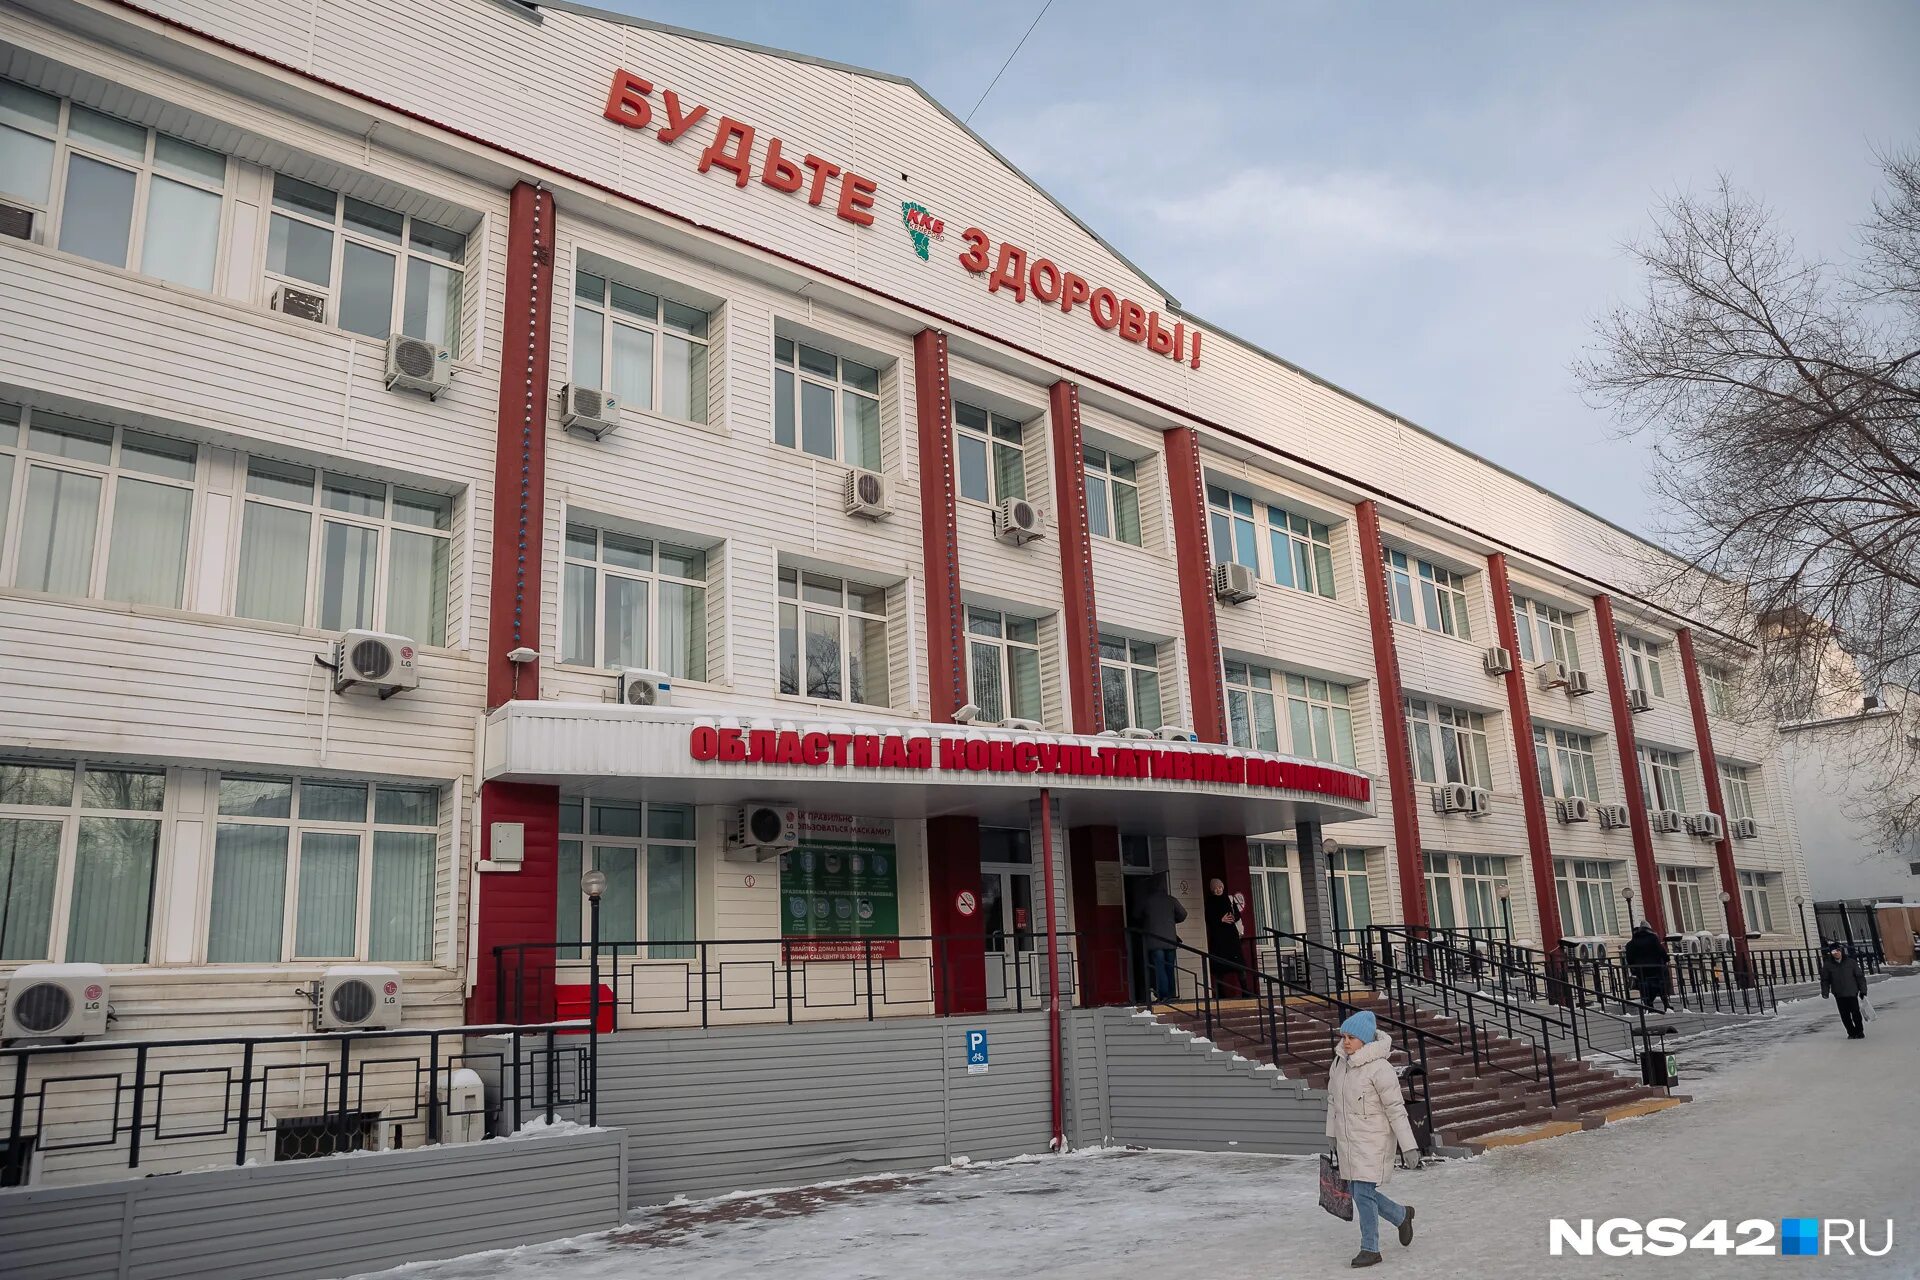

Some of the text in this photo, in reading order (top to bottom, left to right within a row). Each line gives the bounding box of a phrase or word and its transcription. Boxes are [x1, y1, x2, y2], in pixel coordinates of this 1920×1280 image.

[603, 68, 1201, 369] БУДЬТЕ ЗДОРОВЫ!
[907, 208, 944, 234] ККБ
[690, 726, 932, 769] ОБЛАСТНАЯ
[939, 737, 1245, 784] КОНСУЛЬТАТИВНАЯ
[808, 812, 853, 822] ПРАВИЛЬНО
[850, 826, 891, 836] МАСКАМИ?
[971, 1033, 983, 1051] P
